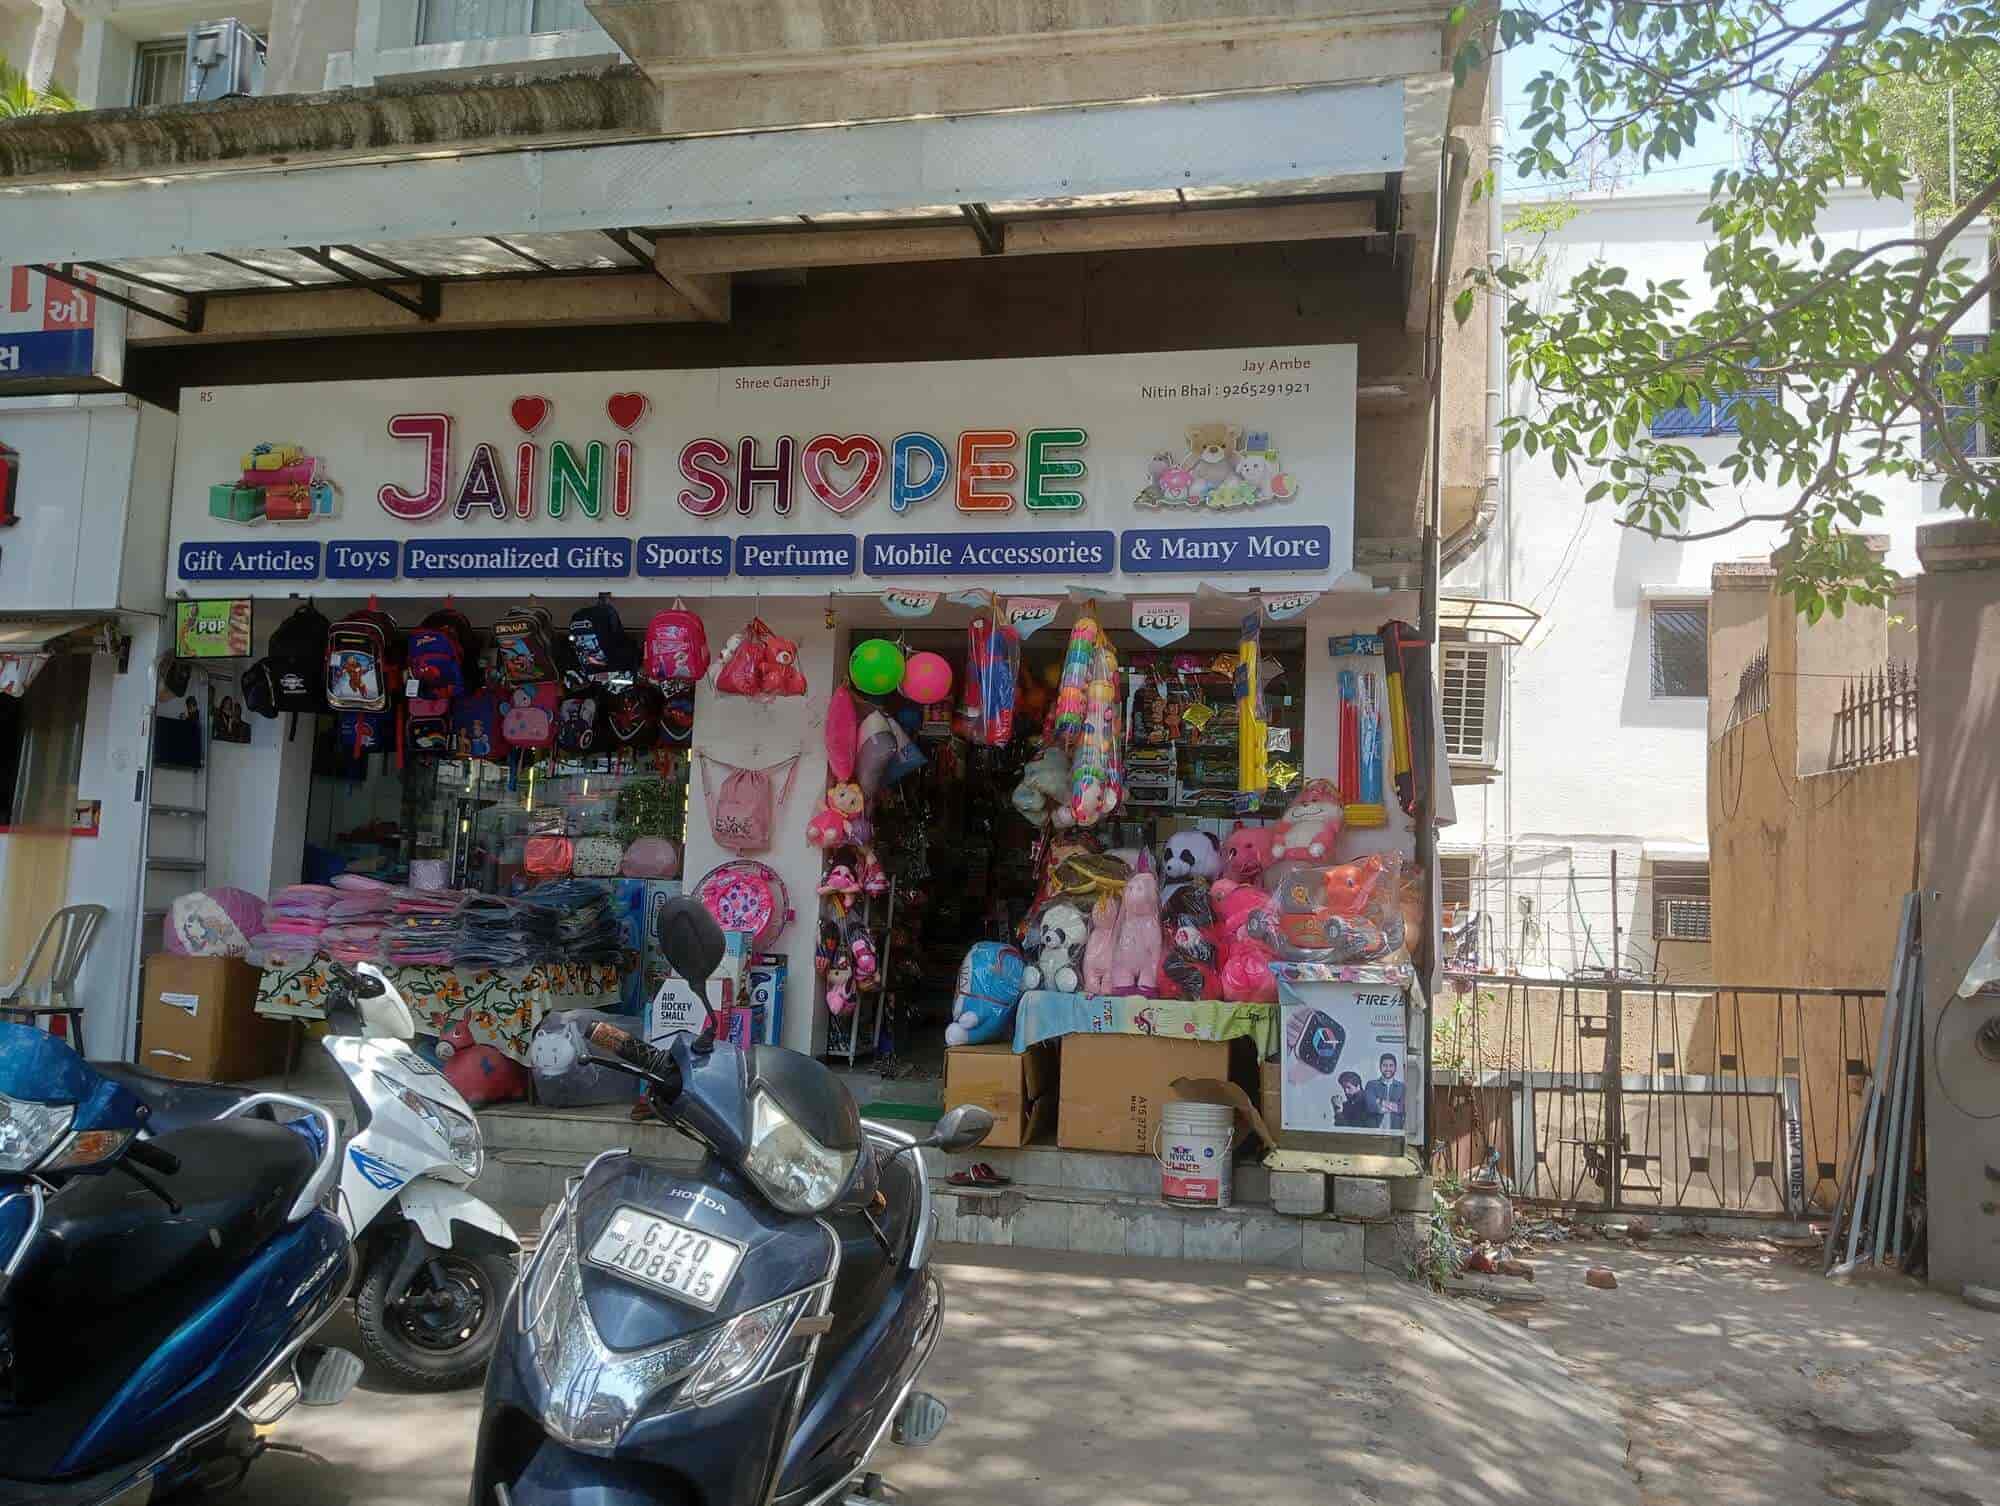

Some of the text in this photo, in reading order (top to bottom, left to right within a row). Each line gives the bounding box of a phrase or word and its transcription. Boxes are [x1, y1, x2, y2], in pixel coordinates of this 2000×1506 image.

[1242, 356, 1311, 375] Jay Ambe
[735, 376, 769, 389] Shree
[773, 375, 819, 388] Ganesh
[1141, 384, 1177, 399] Nitin
[1181, 383, 1211, 397] Bhai
[1223, 382, 1311, 398] 9265291921
[334, 547, 391, 572] Toys
[410, 546, 624, 569] Personalized Gifts
[645, 543, 722, 569] Sports
[743, 544, 849, 567] Perfume
[874, 540, 1103, 566] Mobile Accessories
[1131, 535, 1321, 564] & Many More
[184, 550, 315, 572] Gift Articles
[197, 620, 226, 635] POP
[1140, 614, 1182, 629] POP
[660, 1002, 692, 1012] HOCKEY
[662, 992, 676, 1001] AIR
[660, 1012, 685, 1021] SMALL
[669, 1187, 728, 1216] HONDA
[643, 1222, 712, 1263] GJ20
[611, 1243, 715, 1297] AD8515
